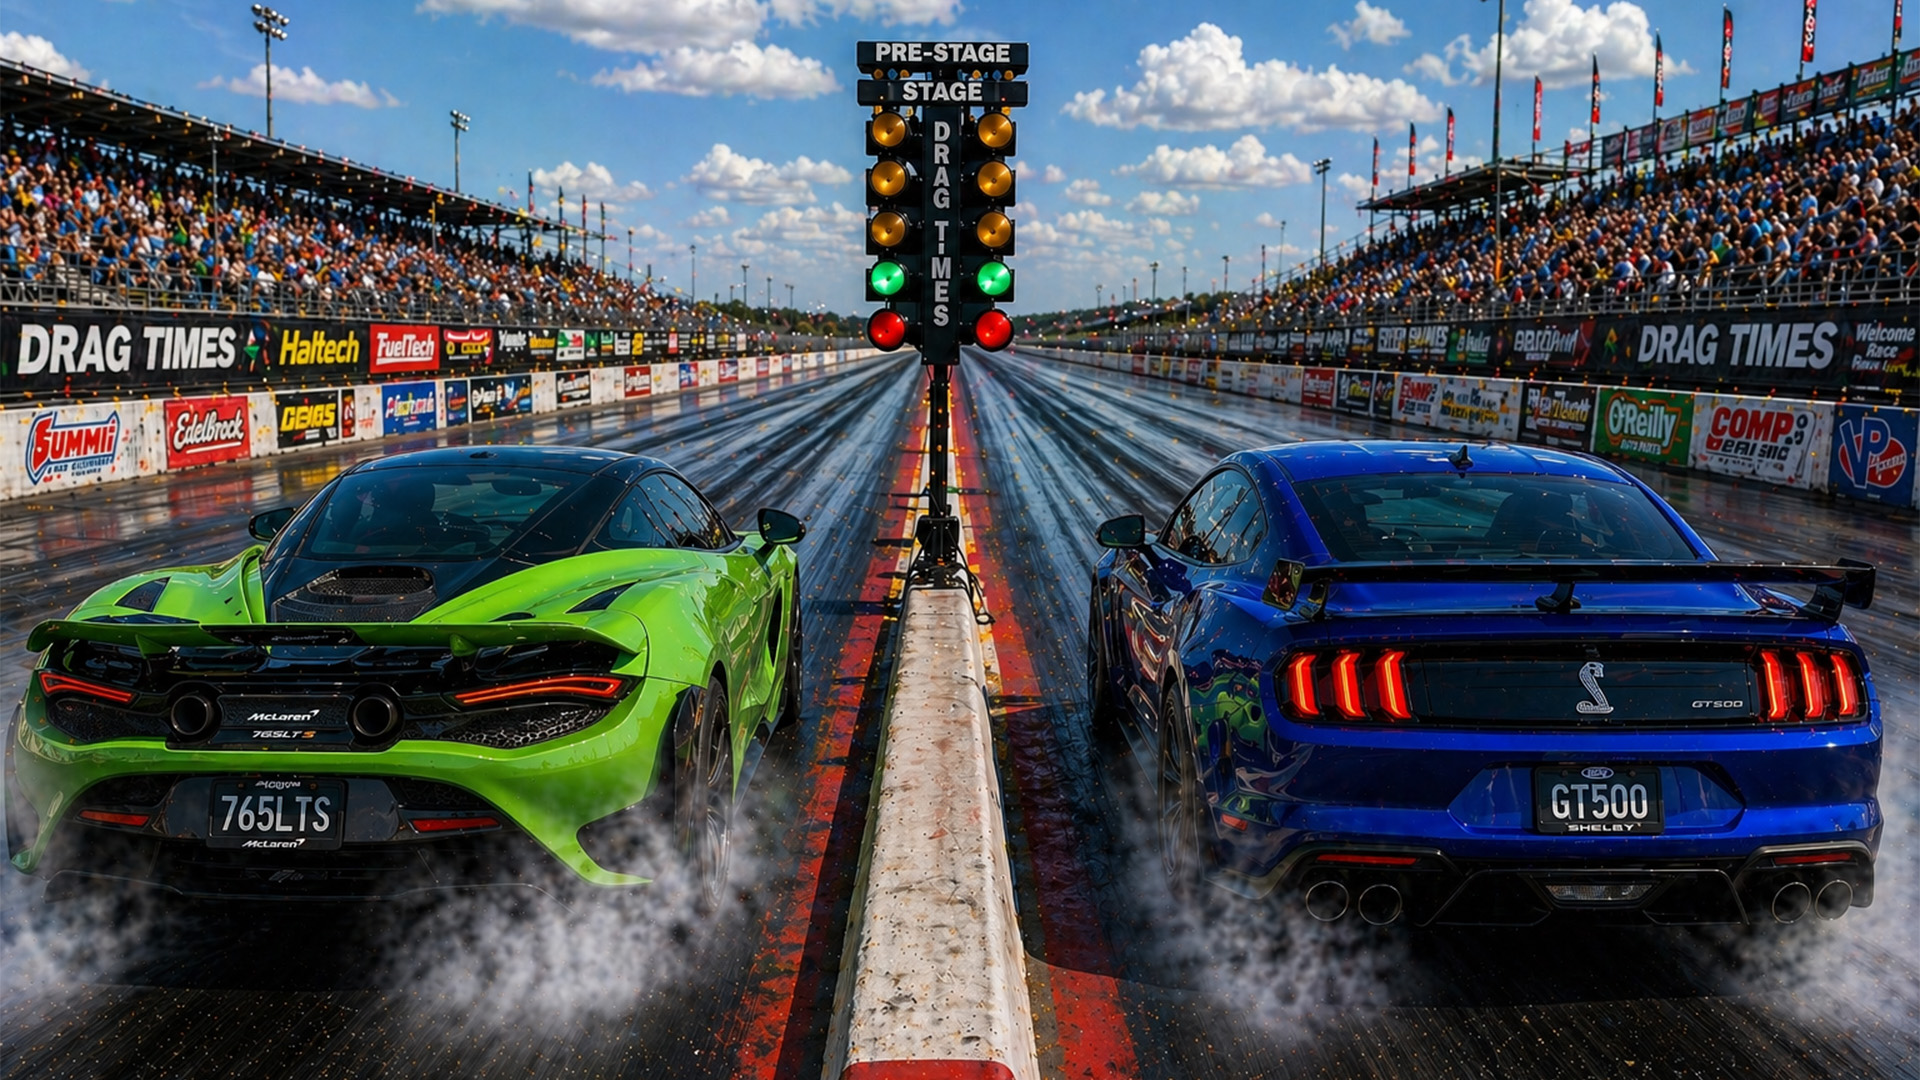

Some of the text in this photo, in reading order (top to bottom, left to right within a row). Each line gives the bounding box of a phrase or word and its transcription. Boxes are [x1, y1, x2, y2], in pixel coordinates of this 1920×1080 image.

[875, 43, 1011, 63] PRE-STAGE
[902, 82, 983, 102] STAGE
[931, 121, 951, 327] DRAG TIMES
[17, 323, 237, 375] DRAG TIMES
[279, 329, 361, 366] Haltech
[376, 331, 435, 359] FuelTech
[1637, 321, 1839, 370] DRAG TIMES
[1856, 322, 1916, 342] Welcome
[173, 409, 245, 450] Edelbrock
[1609, 399, 1677, 448] O'Reilly
[1711, 406, 1795, 443] COMP
[1839, 416, 1892, 490] VP
[247, 711, 316, 721] McLaren
[1692, 700, 1743, 709] GT500
[221, 795, 331, 832] 765LTS
[1551, 783, 1648, 820] GT500
[242, 839, 302, 849] McLaren
[1567, 824, 1634, 832] SHELBY
